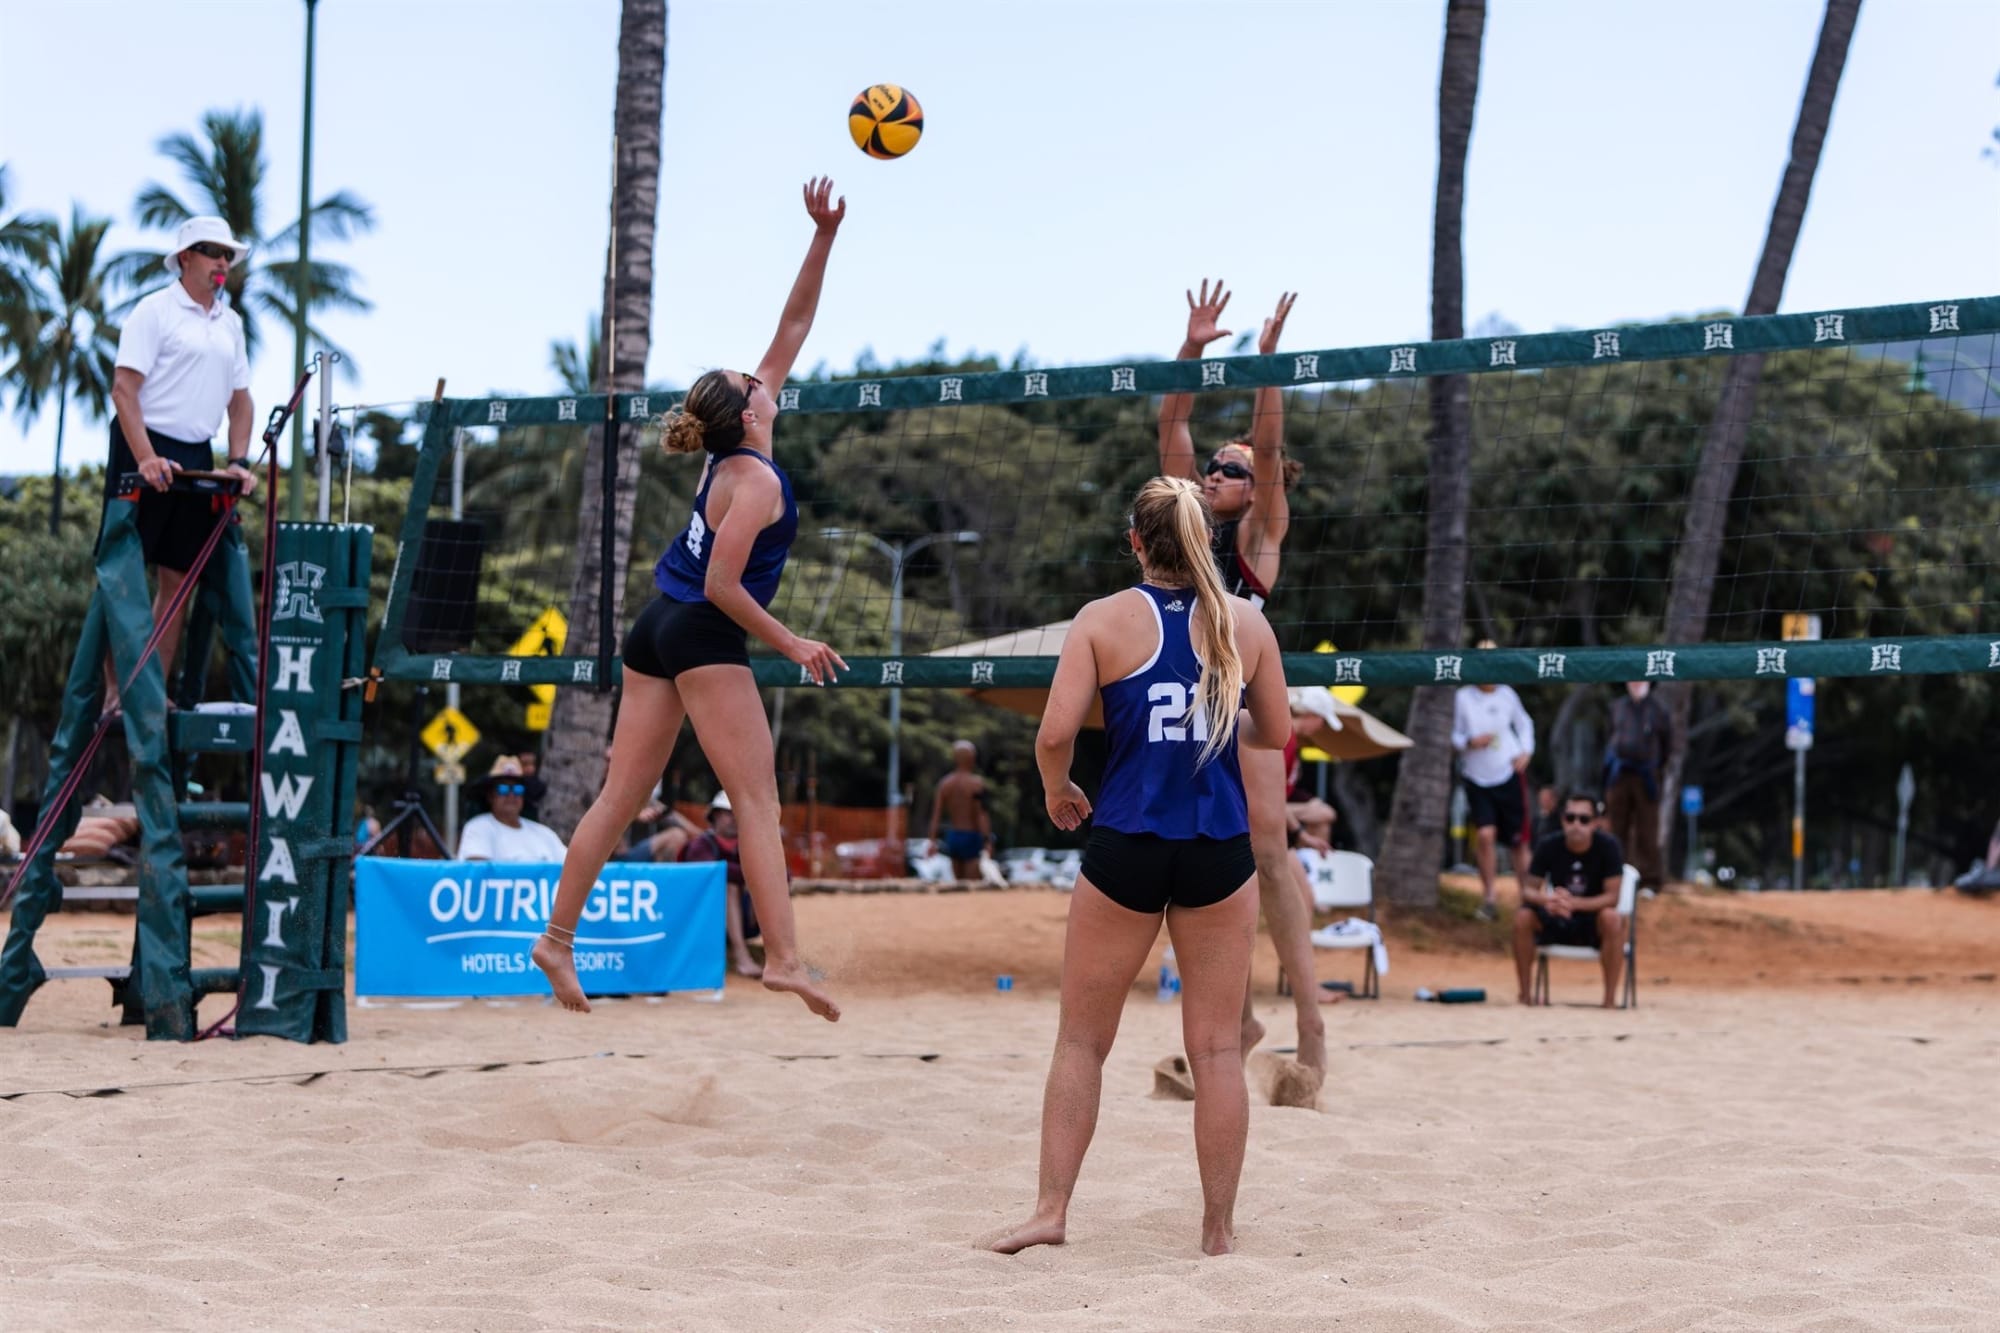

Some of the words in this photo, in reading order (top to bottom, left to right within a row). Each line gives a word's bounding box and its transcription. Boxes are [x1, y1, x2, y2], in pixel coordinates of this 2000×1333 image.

[1147, 682, 1208, 742] 21
[429, 878, 659, 923] OUTRIGER
[461, 953, 526, 973] HOTELS
[573, 952, 625, 971] ESORTS
